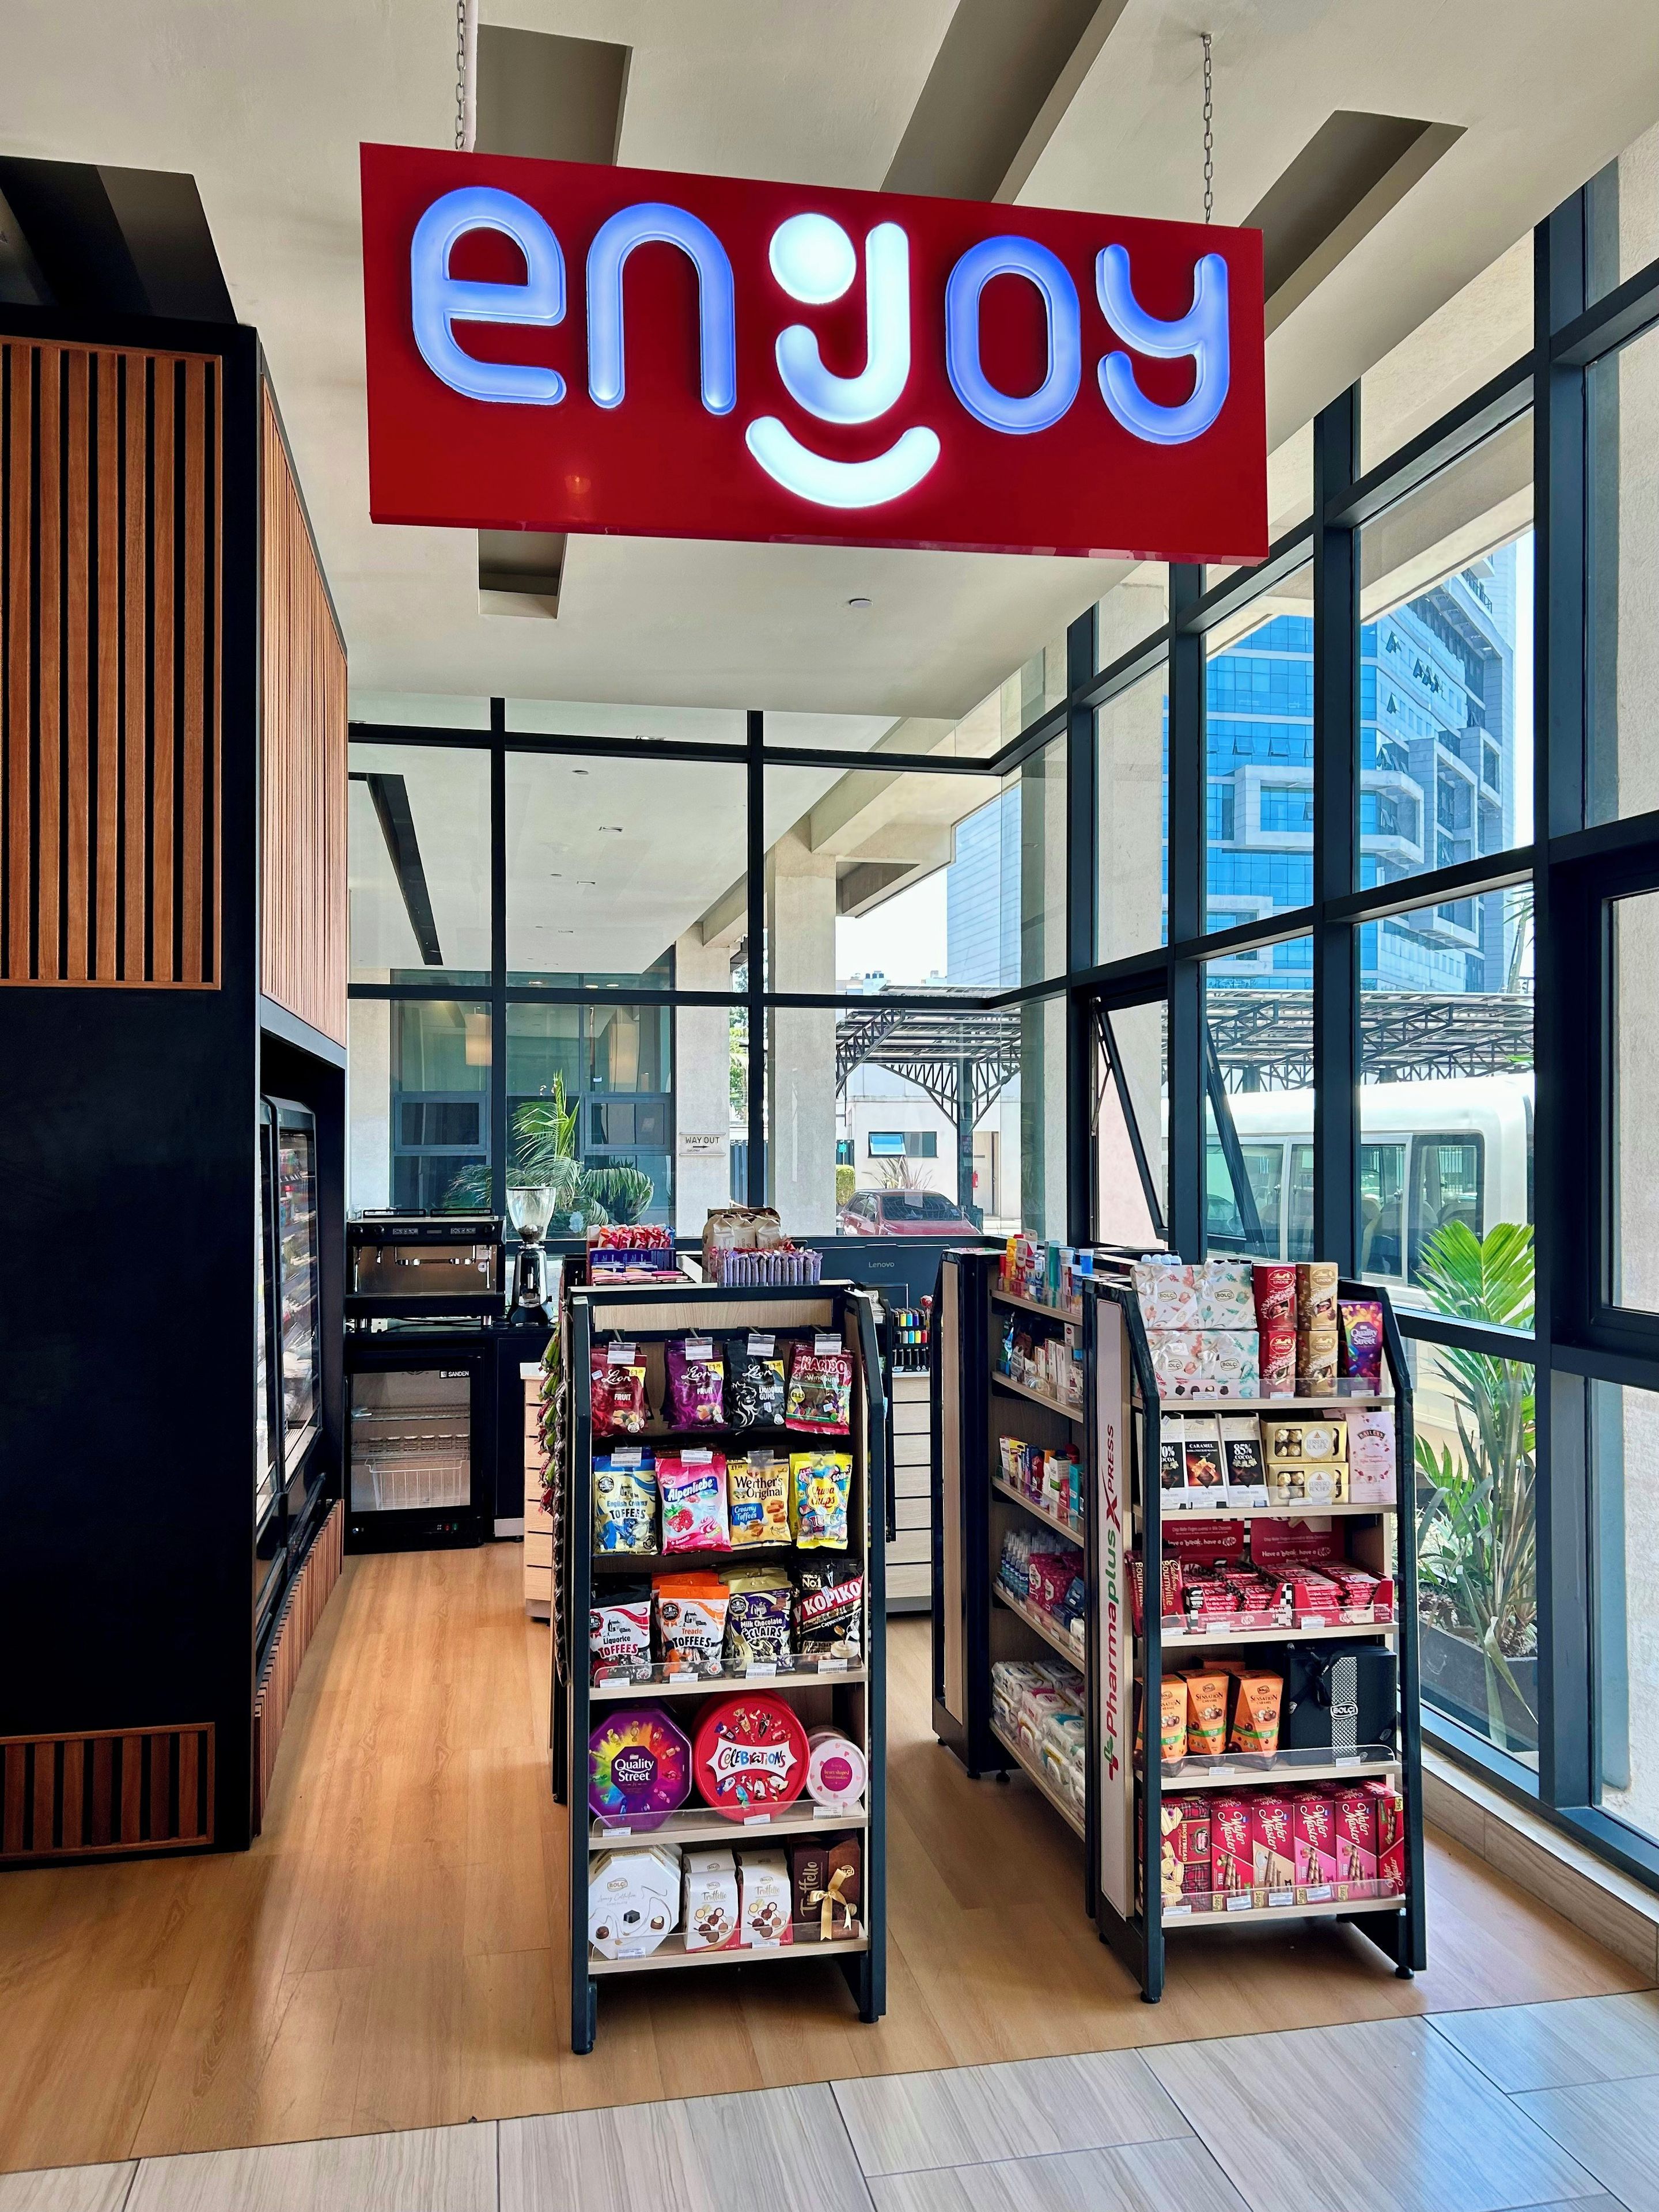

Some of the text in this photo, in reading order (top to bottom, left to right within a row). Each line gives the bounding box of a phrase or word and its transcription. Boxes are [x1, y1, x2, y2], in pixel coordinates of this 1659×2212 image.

[410, 185, 1232, 446] enjoy
[742, 1364, 772, 1378] Lion
[801, 1355, 847, 1374] HARIBO
[601, 1369, 632, 1385] Lion
[681, 1365, 711, 1381] Lion
[614, 1393, 631, 1401] FRUIT
[696, 1387, 713, 1395] FRUIT
[759, 1392, 775, 1400] GUMS
[1161, 1445, 1175, 1458] 0%
[1233, 1444, 1252, 1456] 85%
[734, 1475, 783, 1488] Werther's
[667, 1477, 714, 1502] Alpenliebe
[747, 1486, 783, 1501] Original
[607, 1499, 627, 1508] English
[734, 1506, 757, 1514] Creamy
[609, 1508, 646, 1520] TOFFEES
[737, 1512, 757, 1521] Toffees
[802, 1580, 862, 1616] KOPIKO
[741, 1618, 783, 1628] Milk Chocolate
[821, 1615, 846, 1628] Cappuccino
[603, 1635, 631, 1646] Liquorice
[672, 1636, 712, 1649] TOFFEES
[598, 1643, 638, 1659] TOFFEES
[1195, 1692, 1224, 1700] SENSATION
[1250, 1694, 1278, 1702] SENSATION
[615, 1759, 654, 1773] Quality
[618, 1771, 651, 1782] Street
[1271, 1809, 1287, 1842] Wafer
[1300, 1805, 1319, 1846] Master
[1312, 1804, 1328, 1838] Wafer
[1342, 1803, 1361, 1844] Master
[1354, 1802, 1370, 1836] Wafer
[1217, 1812, 1236, 1853] Master
[1231, 1811, 1247, 1845] Wafer
[1259, 1809, 1277, 1850] Master
[799, 1861, 820, 1917] Trffello
